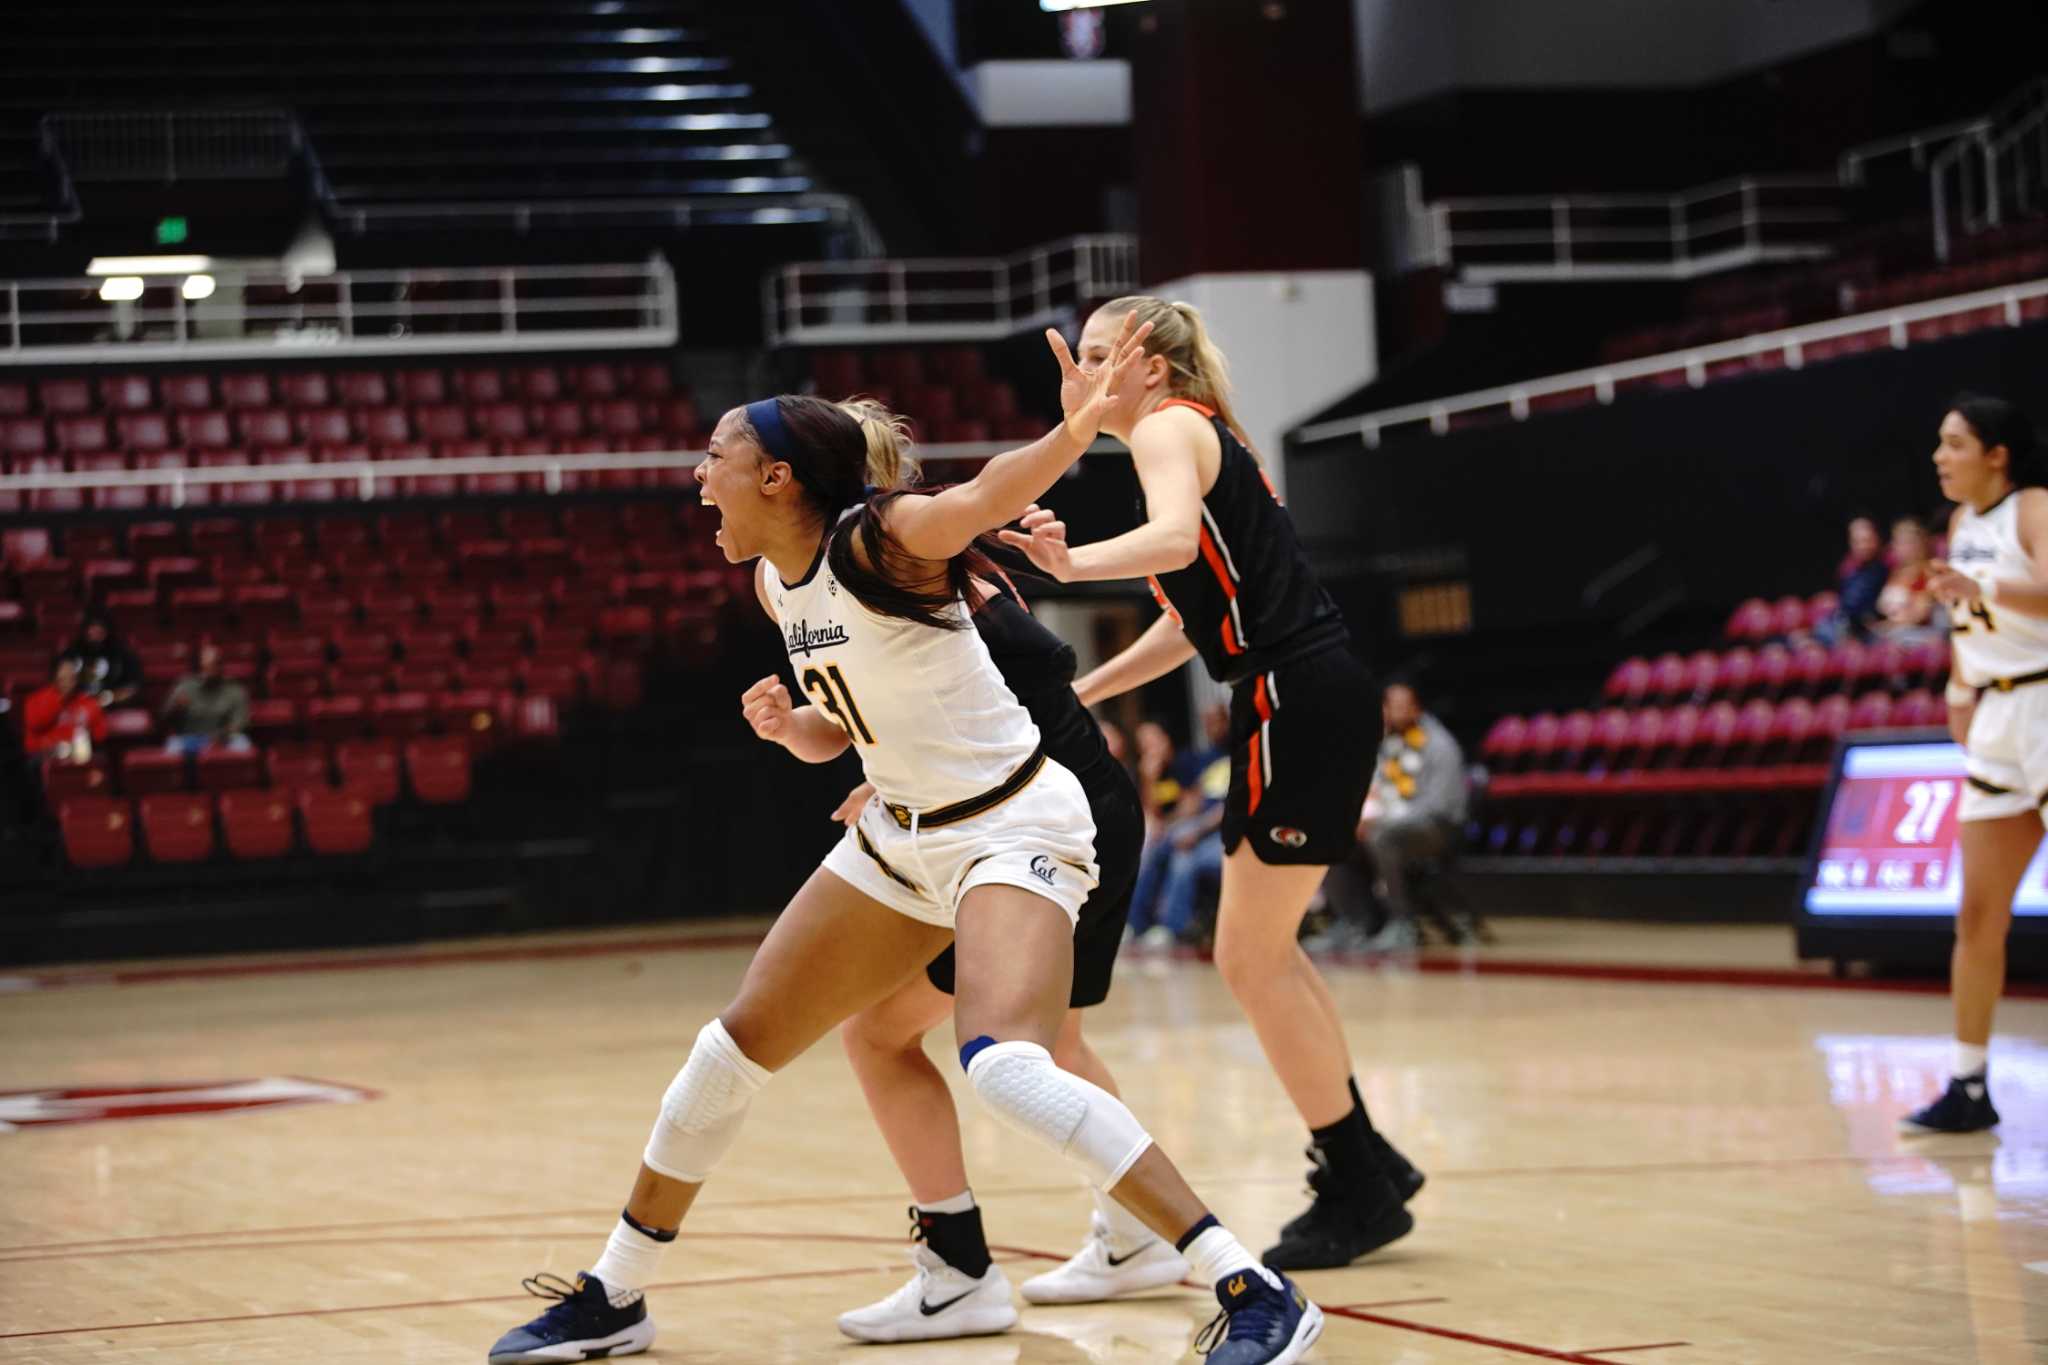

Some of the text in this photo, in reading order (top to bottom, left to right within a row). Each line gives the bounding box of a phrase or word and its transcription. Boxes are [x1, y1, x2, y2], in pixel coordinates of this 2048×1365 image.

[803, 664, 876, 745] 31
[1894, 780, 1954, 843] 27
[1029, 855, 1057, 886] Cal
